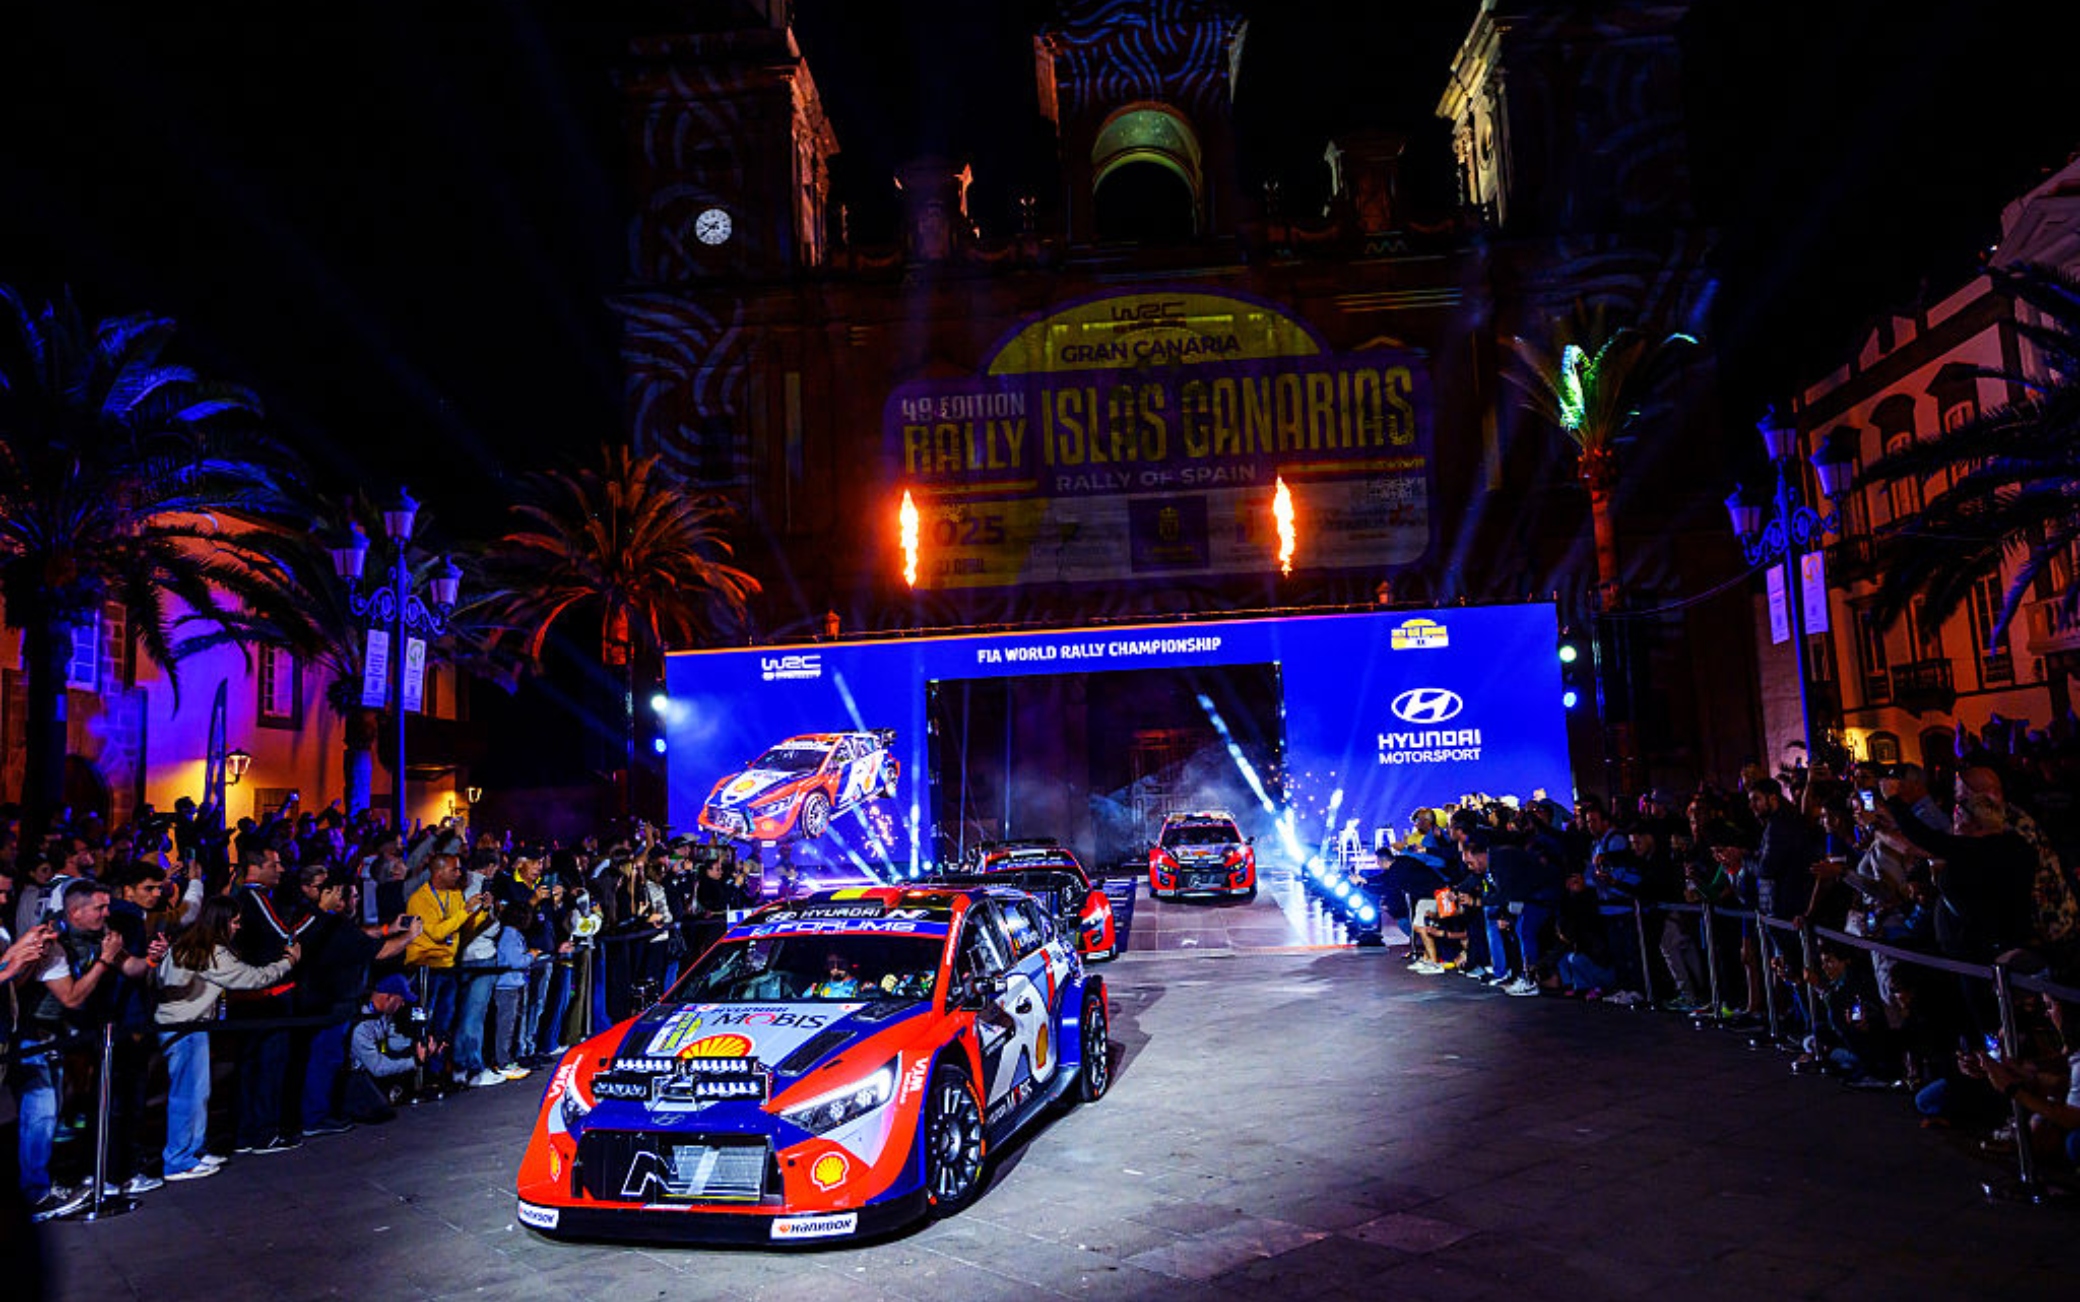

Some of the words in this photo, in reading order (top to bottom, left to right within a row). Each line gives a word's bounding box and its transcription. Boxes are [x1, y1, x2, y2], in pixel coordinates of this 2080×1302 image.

[1111, 302, 1186, 321] WRC
[1061, 341, 1128, 363] GRAN
[1133, 334, 1242, 359] CANARIA
[901, 397, 934, 422] 49
[938, 391, 1026, 421] EDITION
[1041, 381, 1168, 467] ISLAS
[1180, 364, 1417, 458] CANARIAS
[903, 417, 1029, 476] RALLY
[1055, 471, 1132, 493] RALLY
[1139, 470, 1174, 488] OF
[1180, 464, 1257, 486] SPAIN
[977, 649, 1002, 663] FIA
[1004, 645, 1057, 662] WORLD
[1060, 643, 1106, 659] RALLY
[1108, 637, 1222, 657] CHAMPIONSHIP
[761, 654, 822, 671] WRC
[1377, 728, 1482, 750] HYUNDAI
[1379, 747, 1481, 765] MOTORSPORT
[800, 907, 881, 919] HYUNDAI
[711, 1011, 828, 1029] MOBIS
